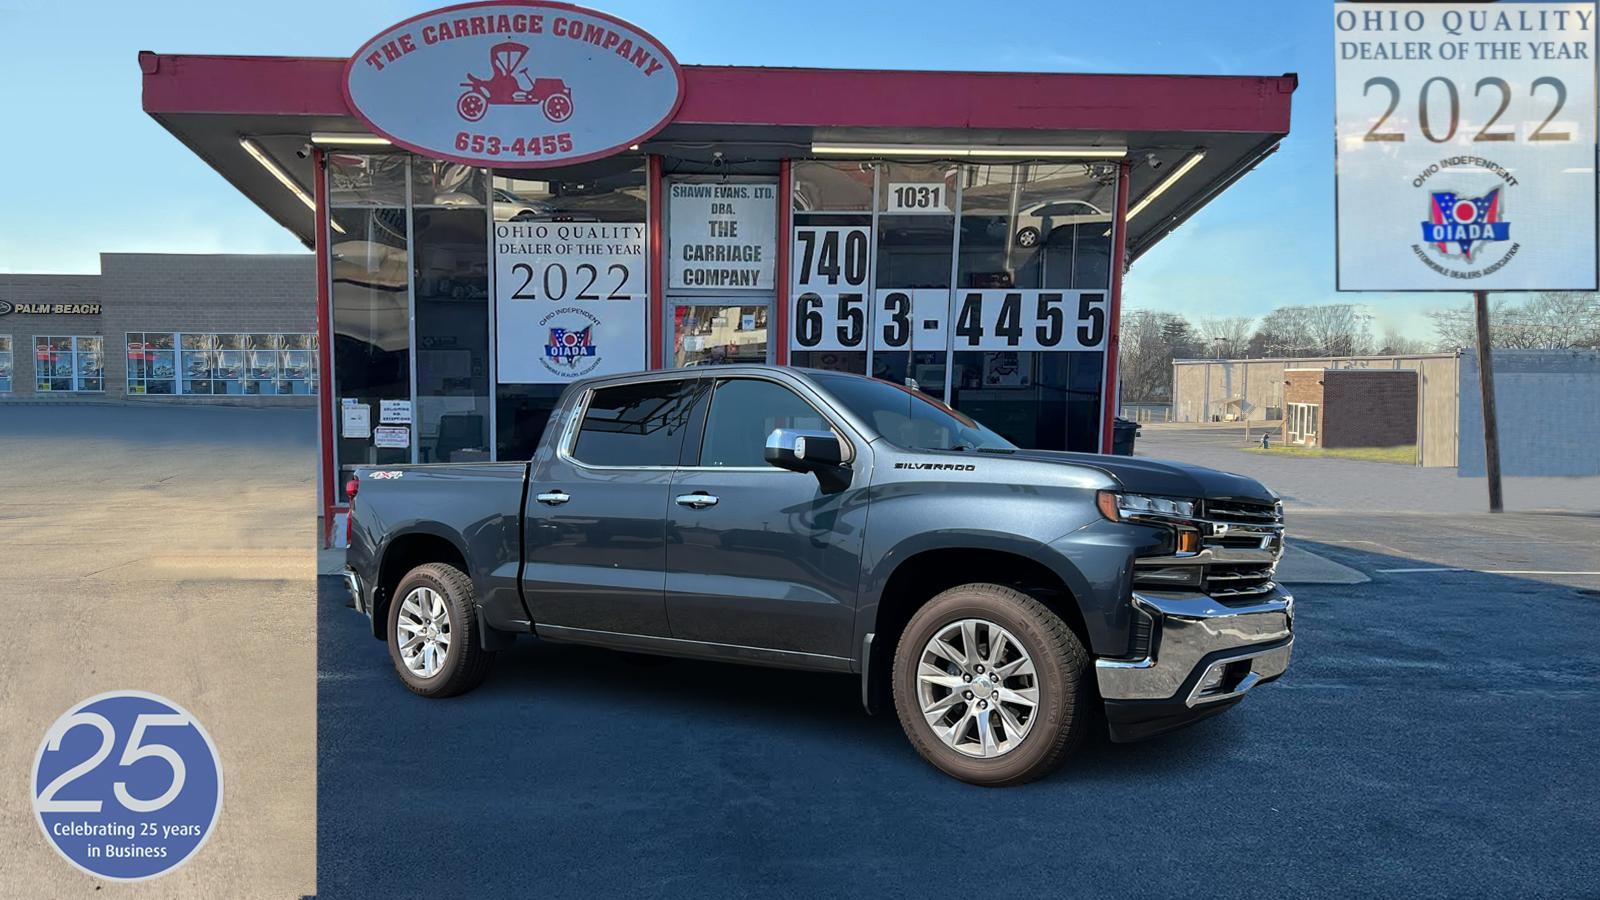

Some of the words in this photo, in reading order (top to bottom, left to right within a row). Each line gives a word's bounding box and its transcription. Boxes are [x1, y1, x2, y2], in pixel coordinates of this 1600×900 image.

[1336, 10, 1425, 31] OHIO
[1442, 10, 1592, 35] QUALITY
[366, 34, 416, 71] THE
[422, 14, 543, 45] CARRIAGE
[552, 17, 663, 77] COMPANY
[1340, 42, 1432, 60] DEALER
[1439, 42, 1469, 60] OF
[1475, 42, 1522, 59] THE
[1528, 42, 1588, 59] YEAR
[1363, 76, 1570, 143] 2022
[455, 132, 572, 156] 653-4455
[1412, 164, 1439, 188] OHIO
[1440, 155, 1519, 187] INDEPENDENT
[673, 186, 711, 198] SHAWN
[754, 187, 774, 199] LTD.
[894, 187, 940, 208] 1031
[711, 203, 735, 214] DBA.
[497, 226, 548, 238] OHIO
[557, 226, 643, 240] QUALITY
[709, 221, 737, 237] THE
[1433, 224, 1495, 240] OIADA
[500, 243, 552, 255] DEALER
[555, 243, 573, 255] OF
[576, 244, 603, 255] THE
[607, 244, 641, 255] YEAR
[683, 244, 762, 262] CARRIAGE
[797, 230, 867, 286] 740
[511, 263, 631, 300] 2022
[683, 268, 760, 286] COMPANY
[15, 304, 50, 314] PALM
[55, 304, 100, 314] BEACH
[539, 312, 555, 326] OHIO
[555, 307, 601, 326] INDEPENDENT
[551, 346, 588, 356] OIADA
[894, 463, 976, 471] SILVERADO
